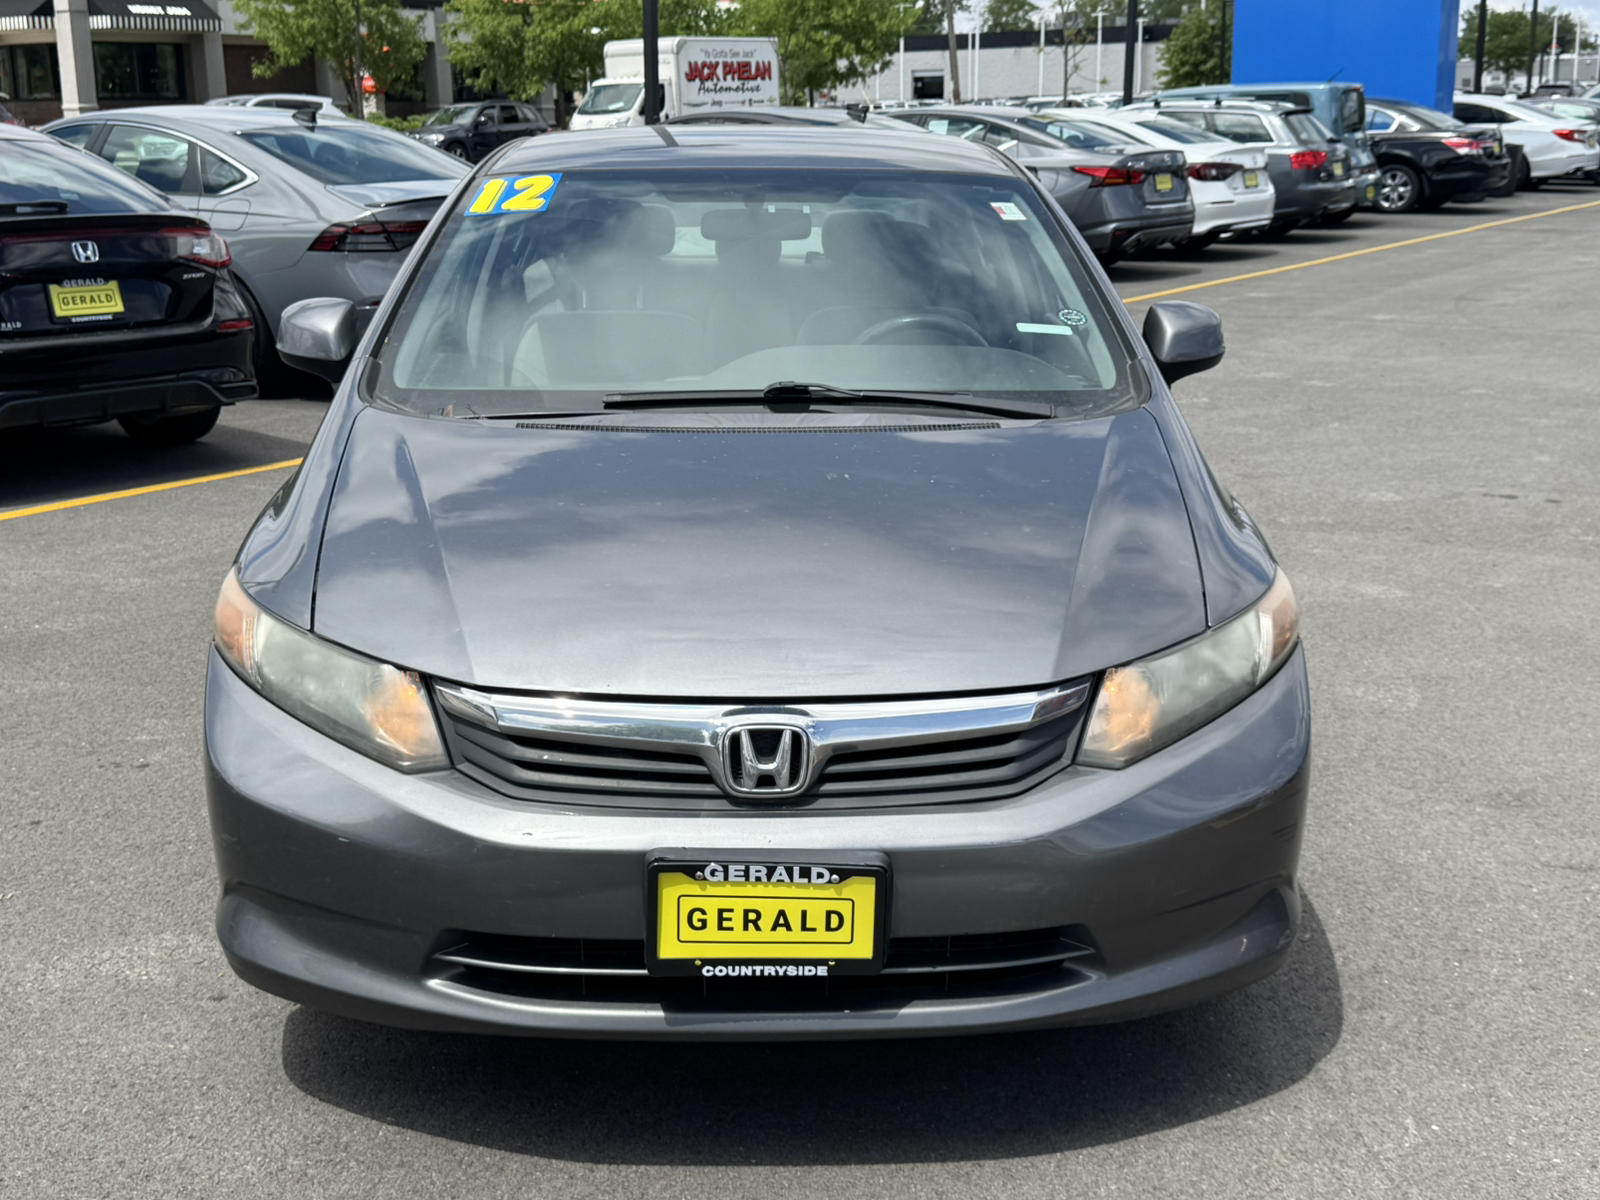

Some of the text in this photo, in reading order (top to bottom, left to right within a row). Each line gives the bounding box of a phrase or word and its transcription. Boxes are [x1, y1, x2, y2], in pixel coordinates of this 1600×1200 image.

[685, 61, 772, 82] JACK PHELAN
[698, 80, 761, 96] Automotive
[469, 174, 555, 213] 12
[63, 277, 105, 287] GERALD
[62, 293, 113, 306] GERALD
[704, 864, 831, 884] GERALD
[687, 907, 845, 932] GERALD
[702, 965, 829, 977] COUNTRYSIDE
